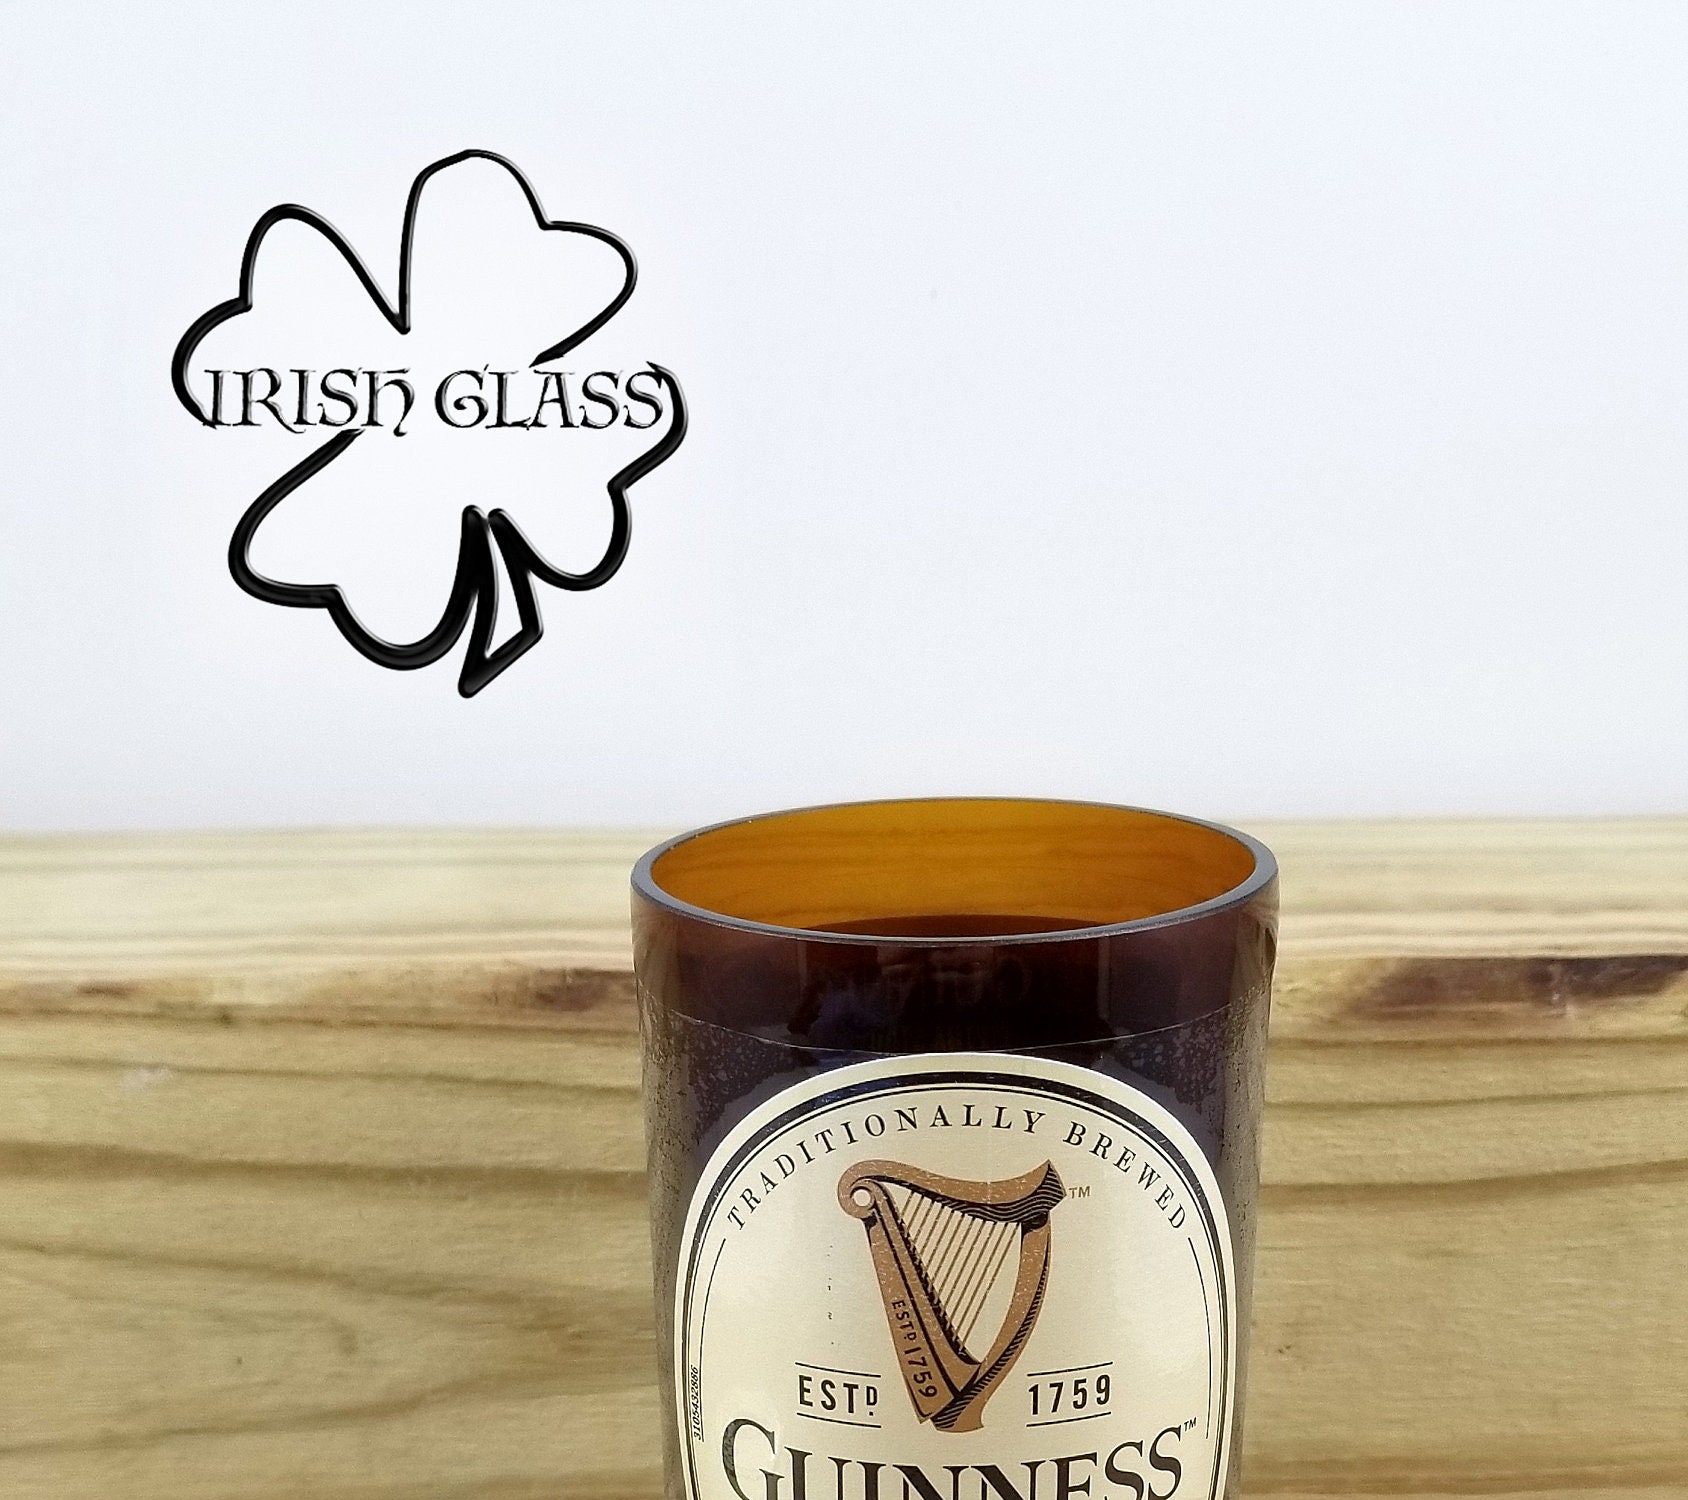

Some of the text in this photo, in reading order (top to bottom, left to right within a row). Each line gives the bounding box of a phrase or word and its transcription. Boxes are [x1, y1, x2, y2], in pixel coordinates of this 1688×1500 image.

[727, 1104, 1188, 1232] TRADITIONALLY BREWED
[692, 1365, 702, 1440] 3105432886
[903, 1344, 937, 1399] 1759
[1026, 1371, 1113, 1417] 1759
